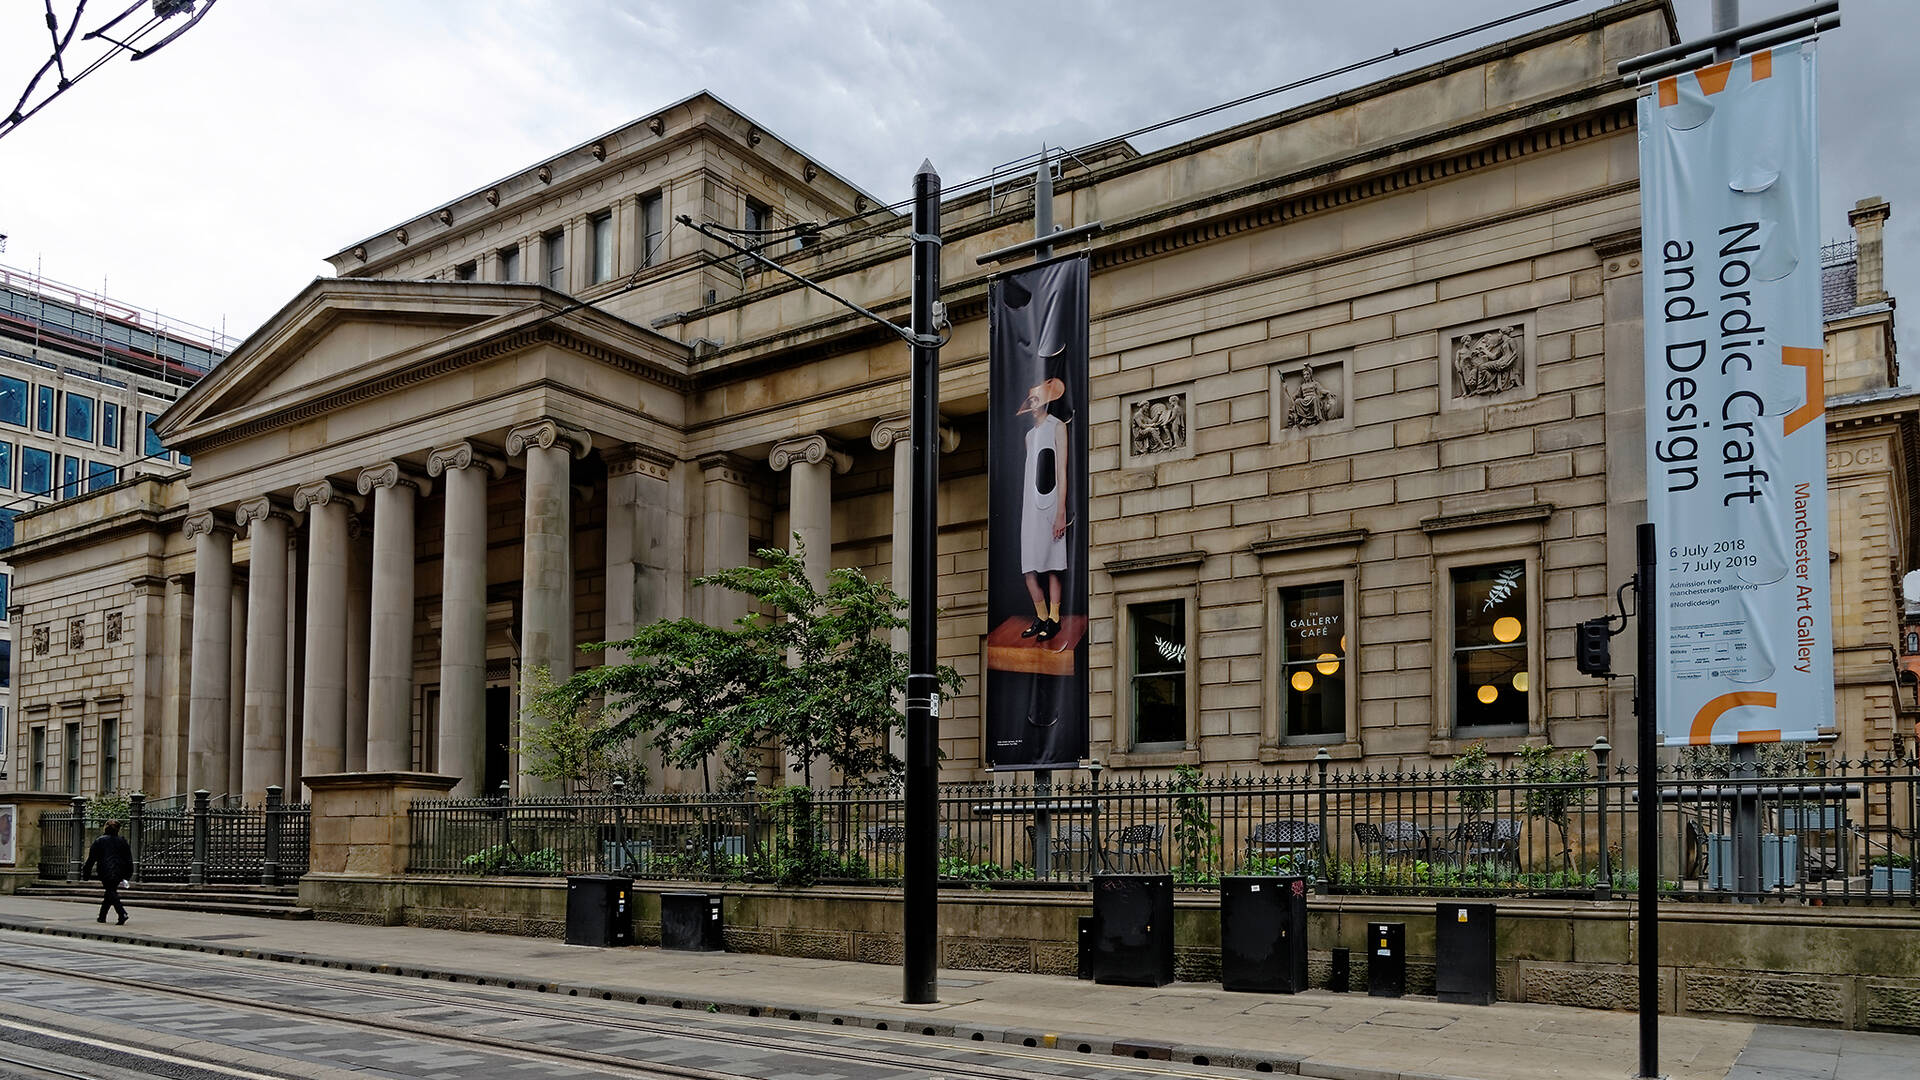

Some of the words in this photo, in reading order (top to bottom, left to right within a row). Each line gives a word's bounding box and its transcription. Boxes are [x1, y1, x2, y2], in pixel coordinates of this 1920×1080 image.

[1663, 240, 1709, 323] and
[1719, 221, 1765, 376] Nordic
[1655, 339, 1710, 493] Design
[1722, 390, 1769, 507] Craft
[1794, 482, 1812, 581] Manchester
[1669, 546, 1678, 558] 6
[1682, 544, 1709, 558] July
[1713, 539, 1746, 554] 2018
[1682, 562, 1690, 573] 7
[1694, 559, 1721, 573] July
[1725, 555, 1758, 569] 2019
[1669, 580, 1706, 589] Admission
[1707, 578, 1722, 586] free
[1669, 583, 1759, 597] manchesterartgallery.org
[1669, 598, 1720, 609] #Nordicdesign
[1796, 584, 1812, 612] Art
[1290, 616, 1339, 628] GALLERY
[1301, 626, 1328, 637] CAFÉ
[1793, 615, 1816, 674] Gallery
